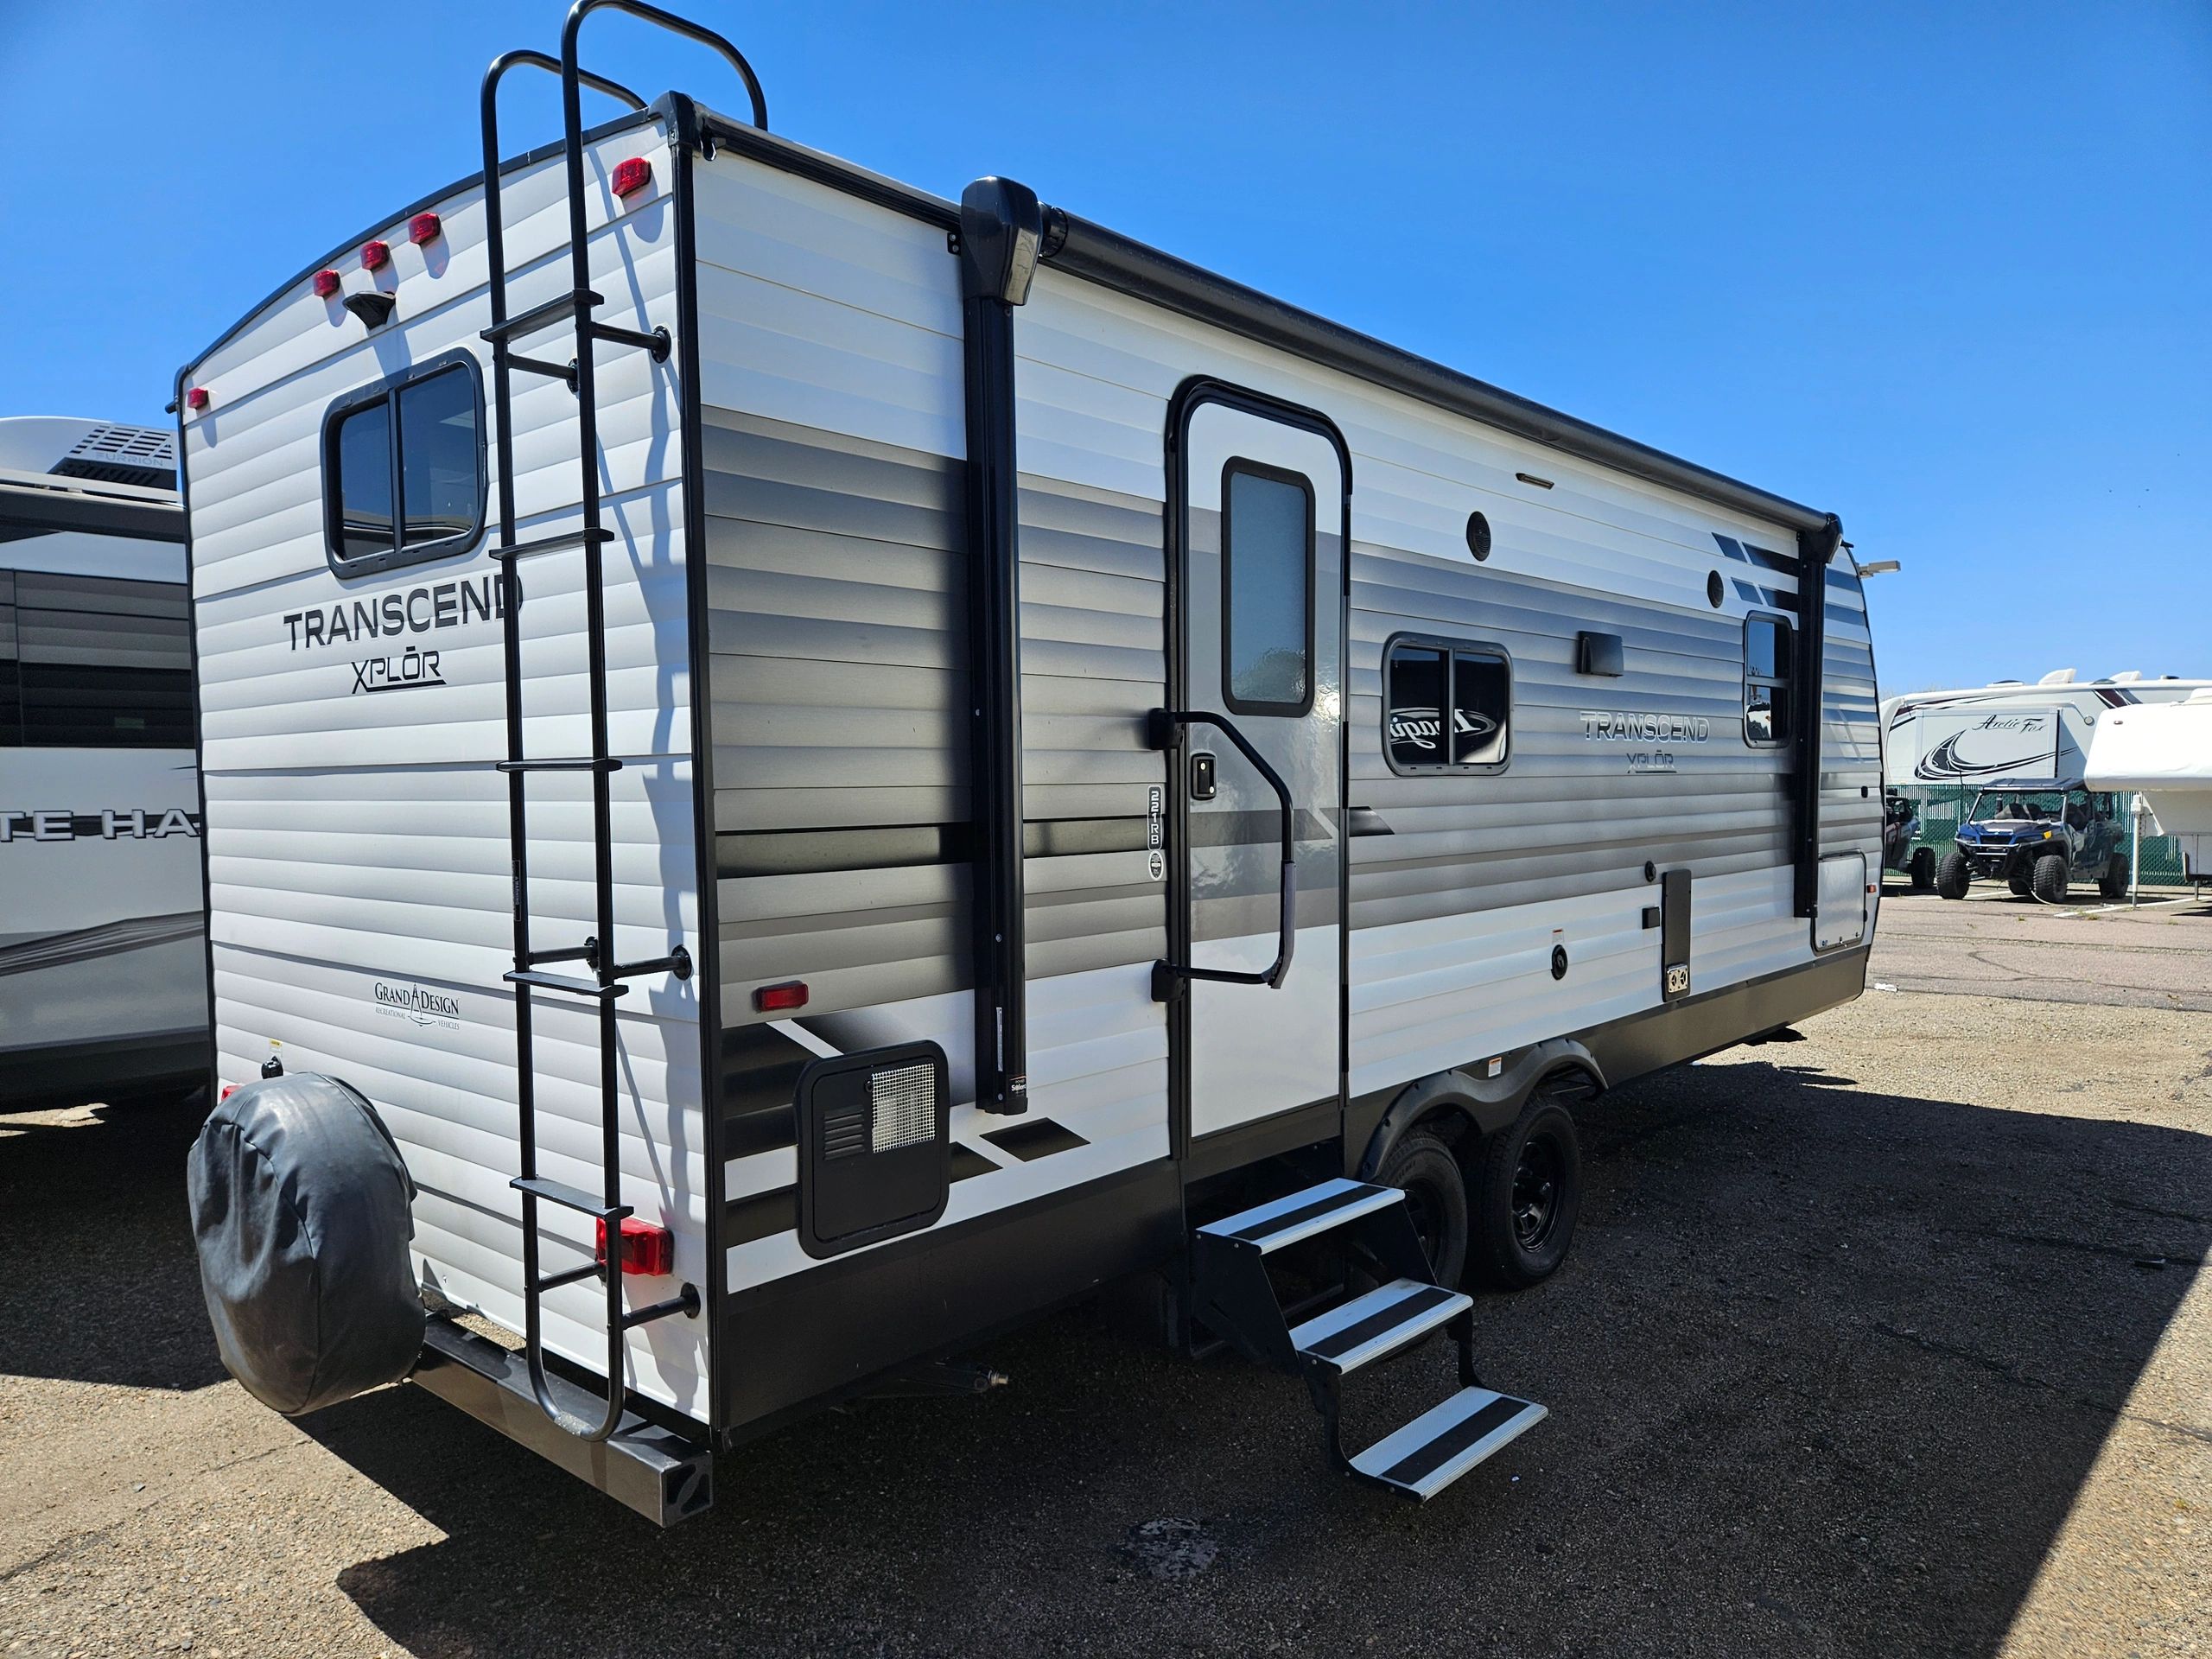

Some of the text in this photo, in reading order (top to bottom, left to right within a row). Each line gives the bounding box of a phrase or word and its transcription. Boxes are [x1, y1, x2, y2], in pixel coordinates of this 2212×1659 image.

[96, 451, 163, 467] FURRION
[283, 574, 524, 651] TRANSCEND
[1580, 711, 1710, 744] TRANSCEND
[1972, 715, 2049, 734] Arctic Fox
[1150, 790, 1160, 845] 221RB
[375, 982, 460, 1014] GRAND DESIGN
[375, 1007, 461, 1031] RECREATIONAL VEHICLES
